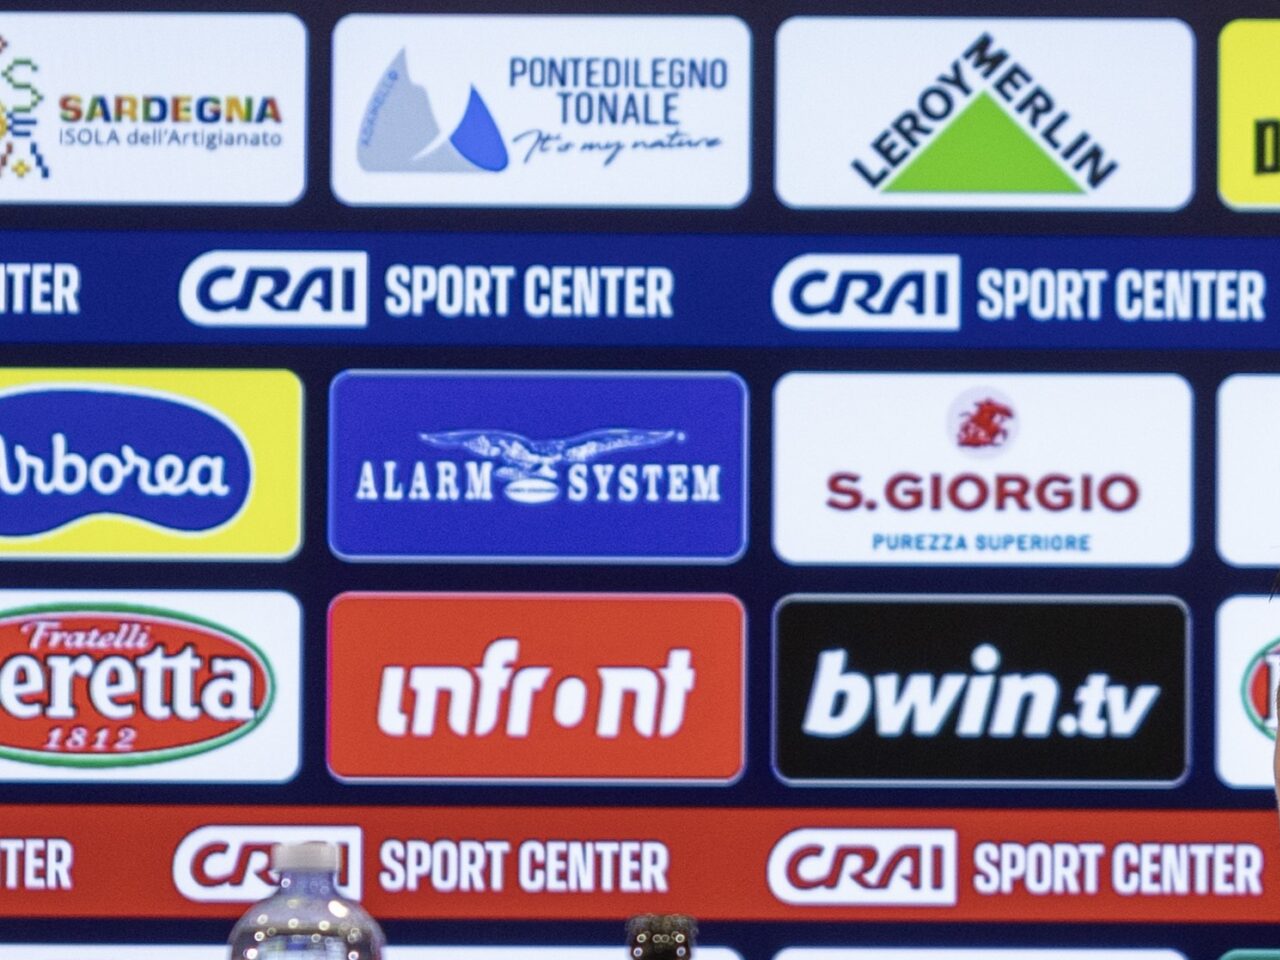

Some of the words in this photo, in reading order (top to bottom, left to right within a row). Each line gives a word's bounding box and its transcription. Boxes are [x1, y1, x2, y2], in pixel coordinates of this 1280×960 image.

[509, 57, 728, 89] PONTEDILEGNO
[59, 95, 283, 123] SARDEGNA
[558, 92, 680, 125] TONALE
[850, 59, 975, 189] LEROY
[962, 30, 1120, 190] MERLIN
[59, 128, 120, 147] ISOLA
[127, 127, 284, 150] dell'Artigianato
[581, 137, 625, 167] my
[200, 266, 357, 313] CRAI
[384, 263, 516, 316] SPORT
[523, 265, 674, 317] CENTER
[788, 269, 949, 315] CRAI
[976, 266, 1108, 321] SPORT
[1114, 268, 1267, 322] CENTER
[356, 461, 493, 501] ALARM
[567, 463, 722, 502] SYSTEM
[825, 471, 1141, 513] S.GIORGIO
[872, 533, 968, 551] PUREZZA
[974, 534, 1092, 553] SUPERIORE
[21, 620, 152, 650] Fratelli
[802, 643, 1160, 738] bwin.tv
[44, 726, 138, 751] 1812
[190, 841, 350, 887] CRI
[379, 839, 510, 891] SPORT
[518, 839, 670, 892] CENTER
[785, 843, 945, 890] CRAI
[973, 841, 1105, 895] SPORT
[1112, 842, 1264, 896] CENTER
